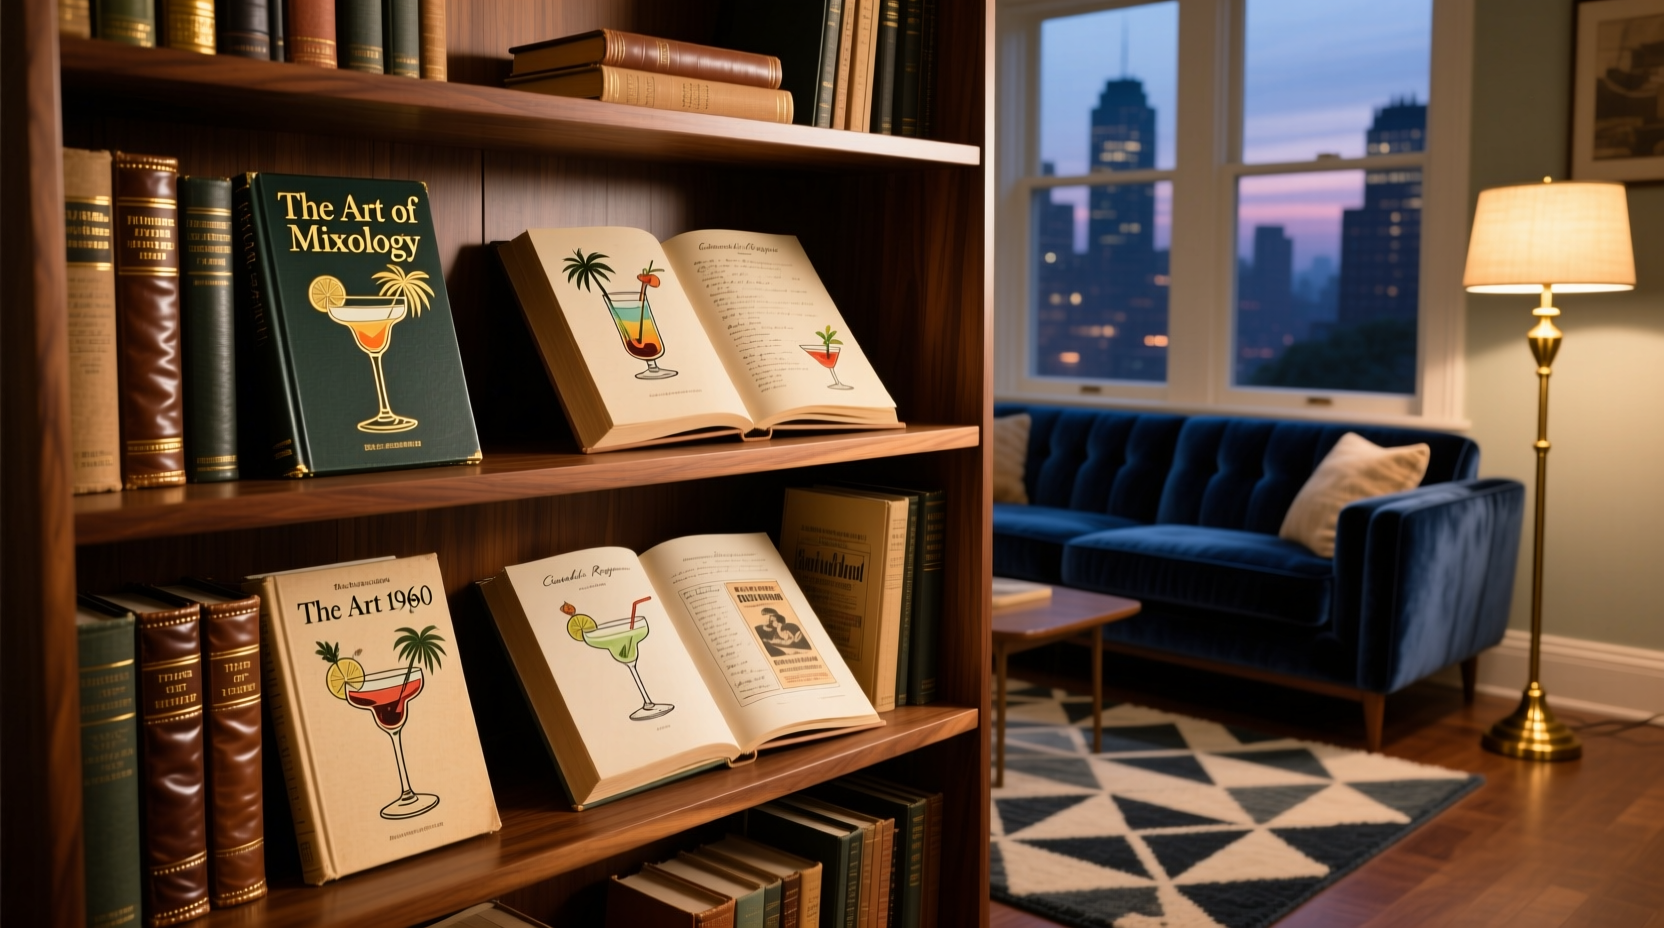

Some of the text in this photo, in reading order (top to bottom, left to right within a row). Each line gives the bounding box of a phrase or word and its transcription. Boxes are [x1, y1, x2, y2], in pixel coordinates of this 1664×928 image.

[277, 191, 419, 223] The Art of
[287, 224, 421, 262] Mixology
[297, 599, 342, 625] The
[348, 594, 383, 617] Art
[386, 584, 433, 611] 1960
